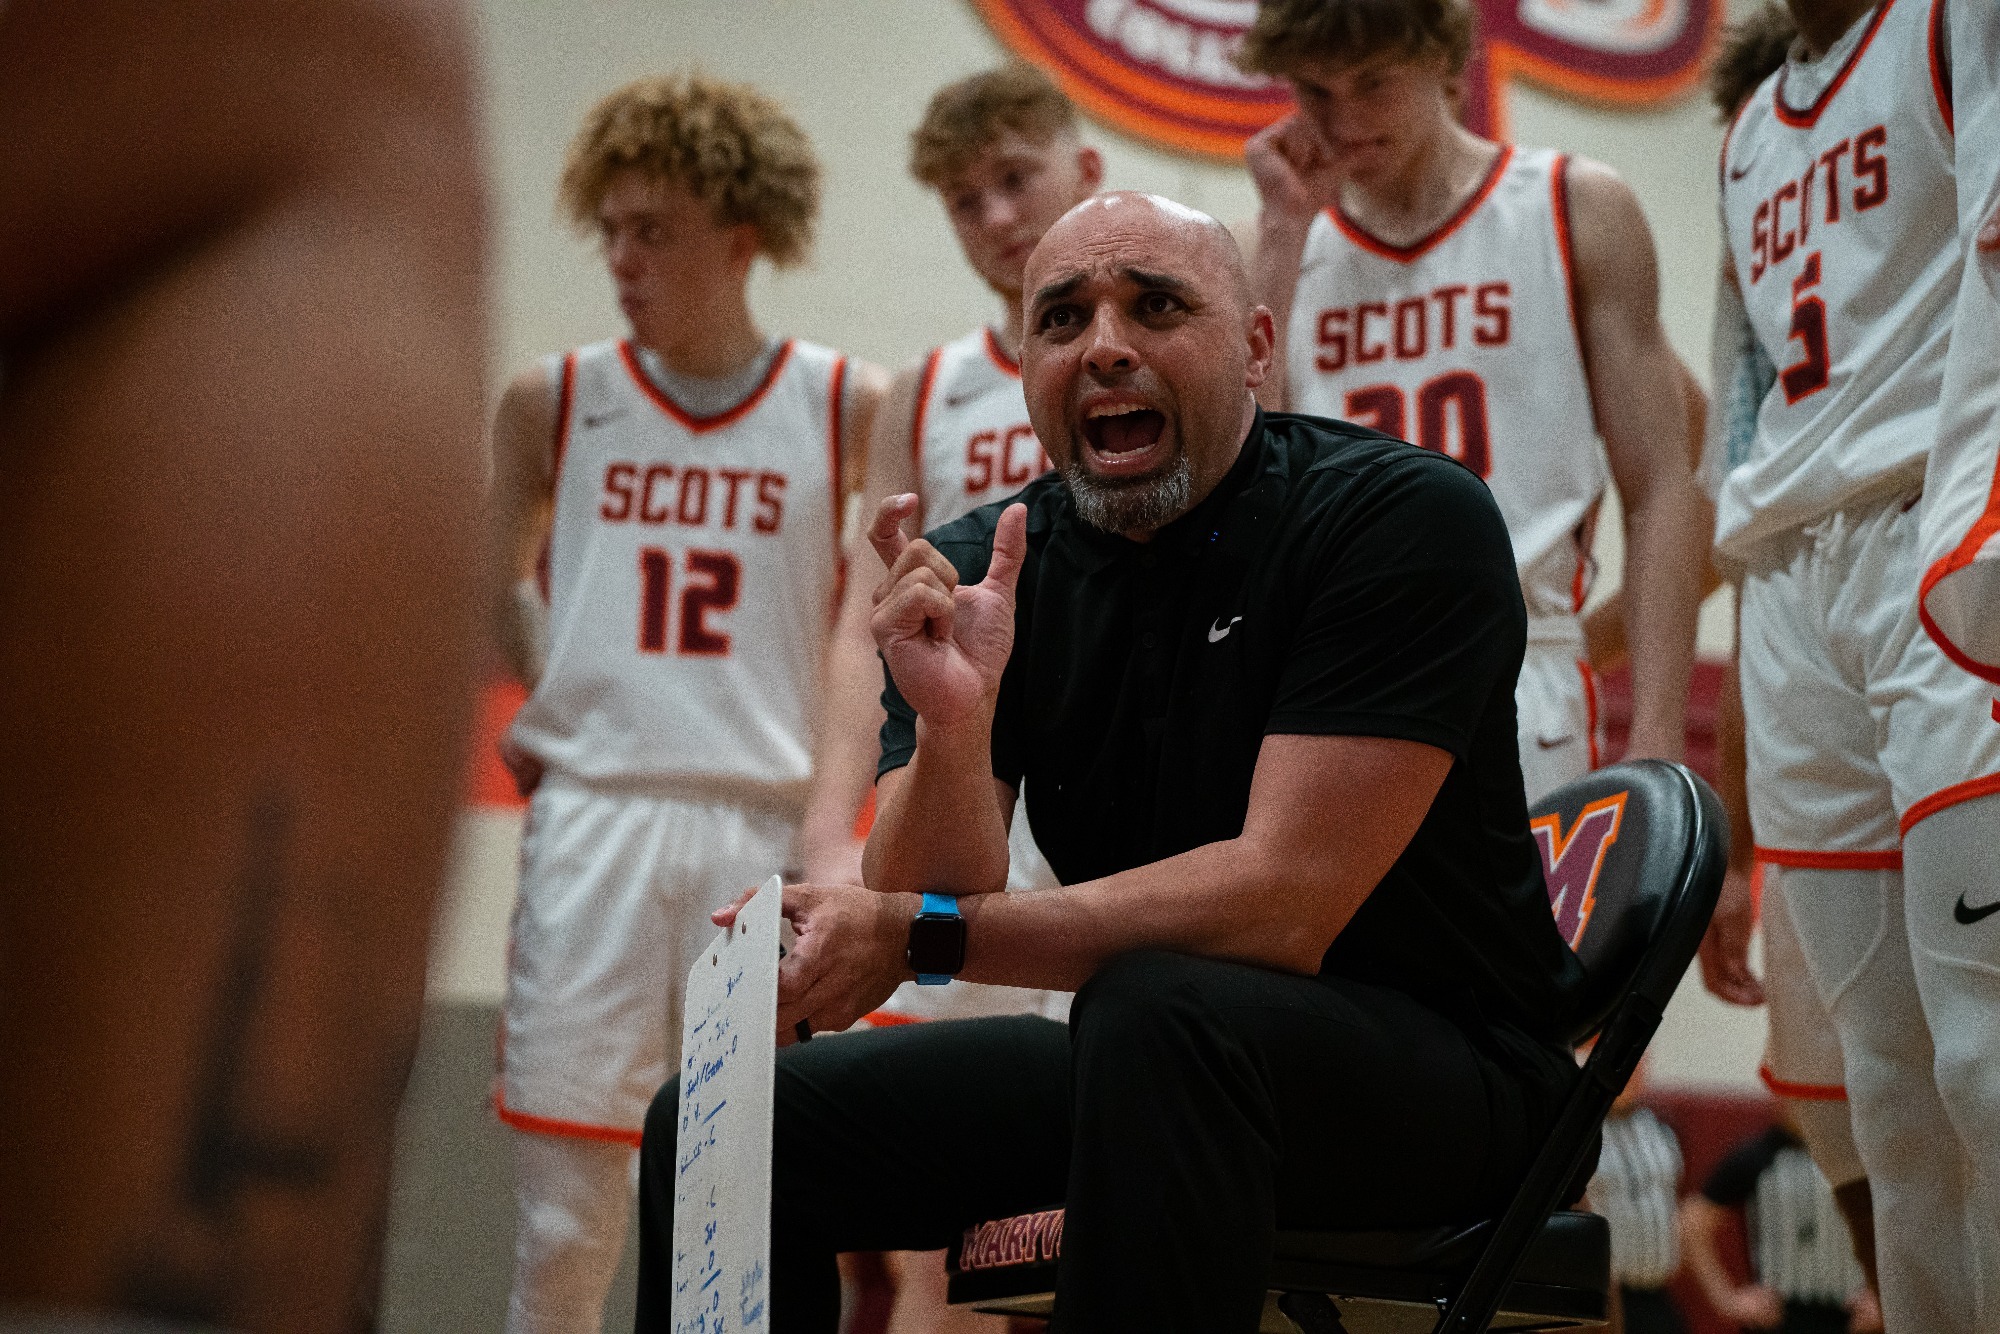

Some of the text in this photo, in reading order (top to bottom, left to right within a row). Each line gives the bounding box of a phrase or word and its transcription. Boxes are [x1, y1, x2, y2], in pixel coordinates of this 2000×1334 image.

[1316, 280, 1509, 373] SCOTS
[1779, 250, 1829, 405] 5
[601, 463, 787, 534] SCOTS
[965, 425, 1052, 494] SC
[638, 548, 741, 656] 12
[959, 1208, 1066, 1271] MARYV
